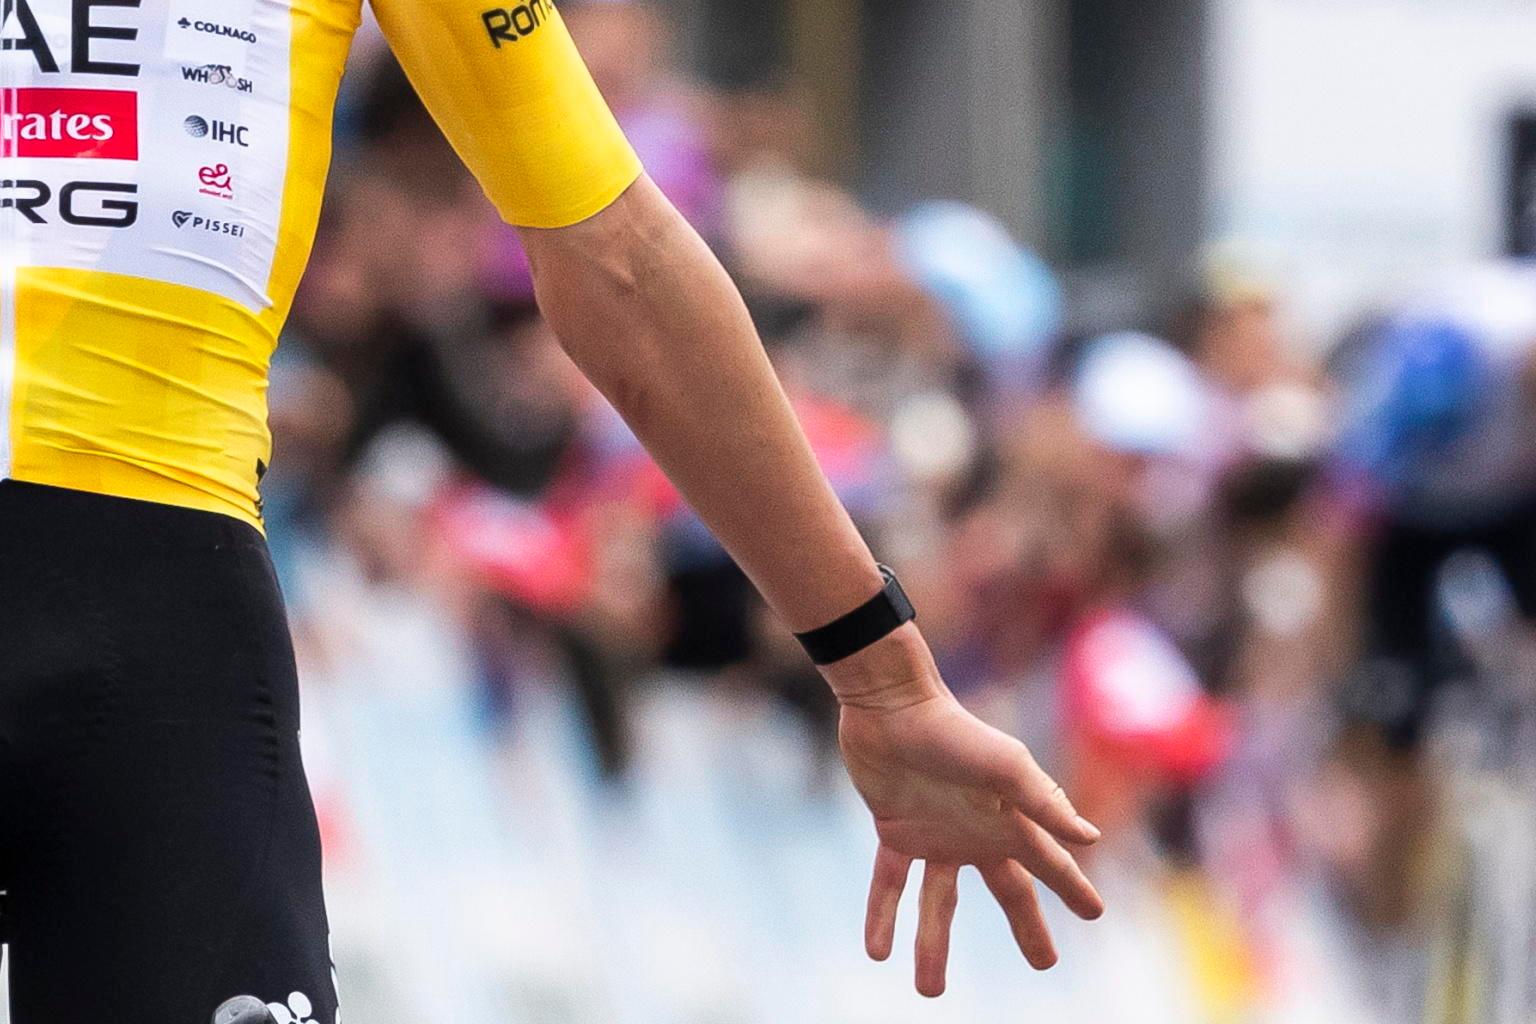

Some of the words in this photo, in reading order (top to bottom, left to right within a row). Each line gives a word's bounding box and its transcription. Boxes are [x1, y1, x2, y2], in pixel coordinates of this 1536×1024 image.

[194, 20, 257, 44] COLNAGO
[212, 119, 249, 147] IHC
[192, 216, 245, 238] PISSEI
